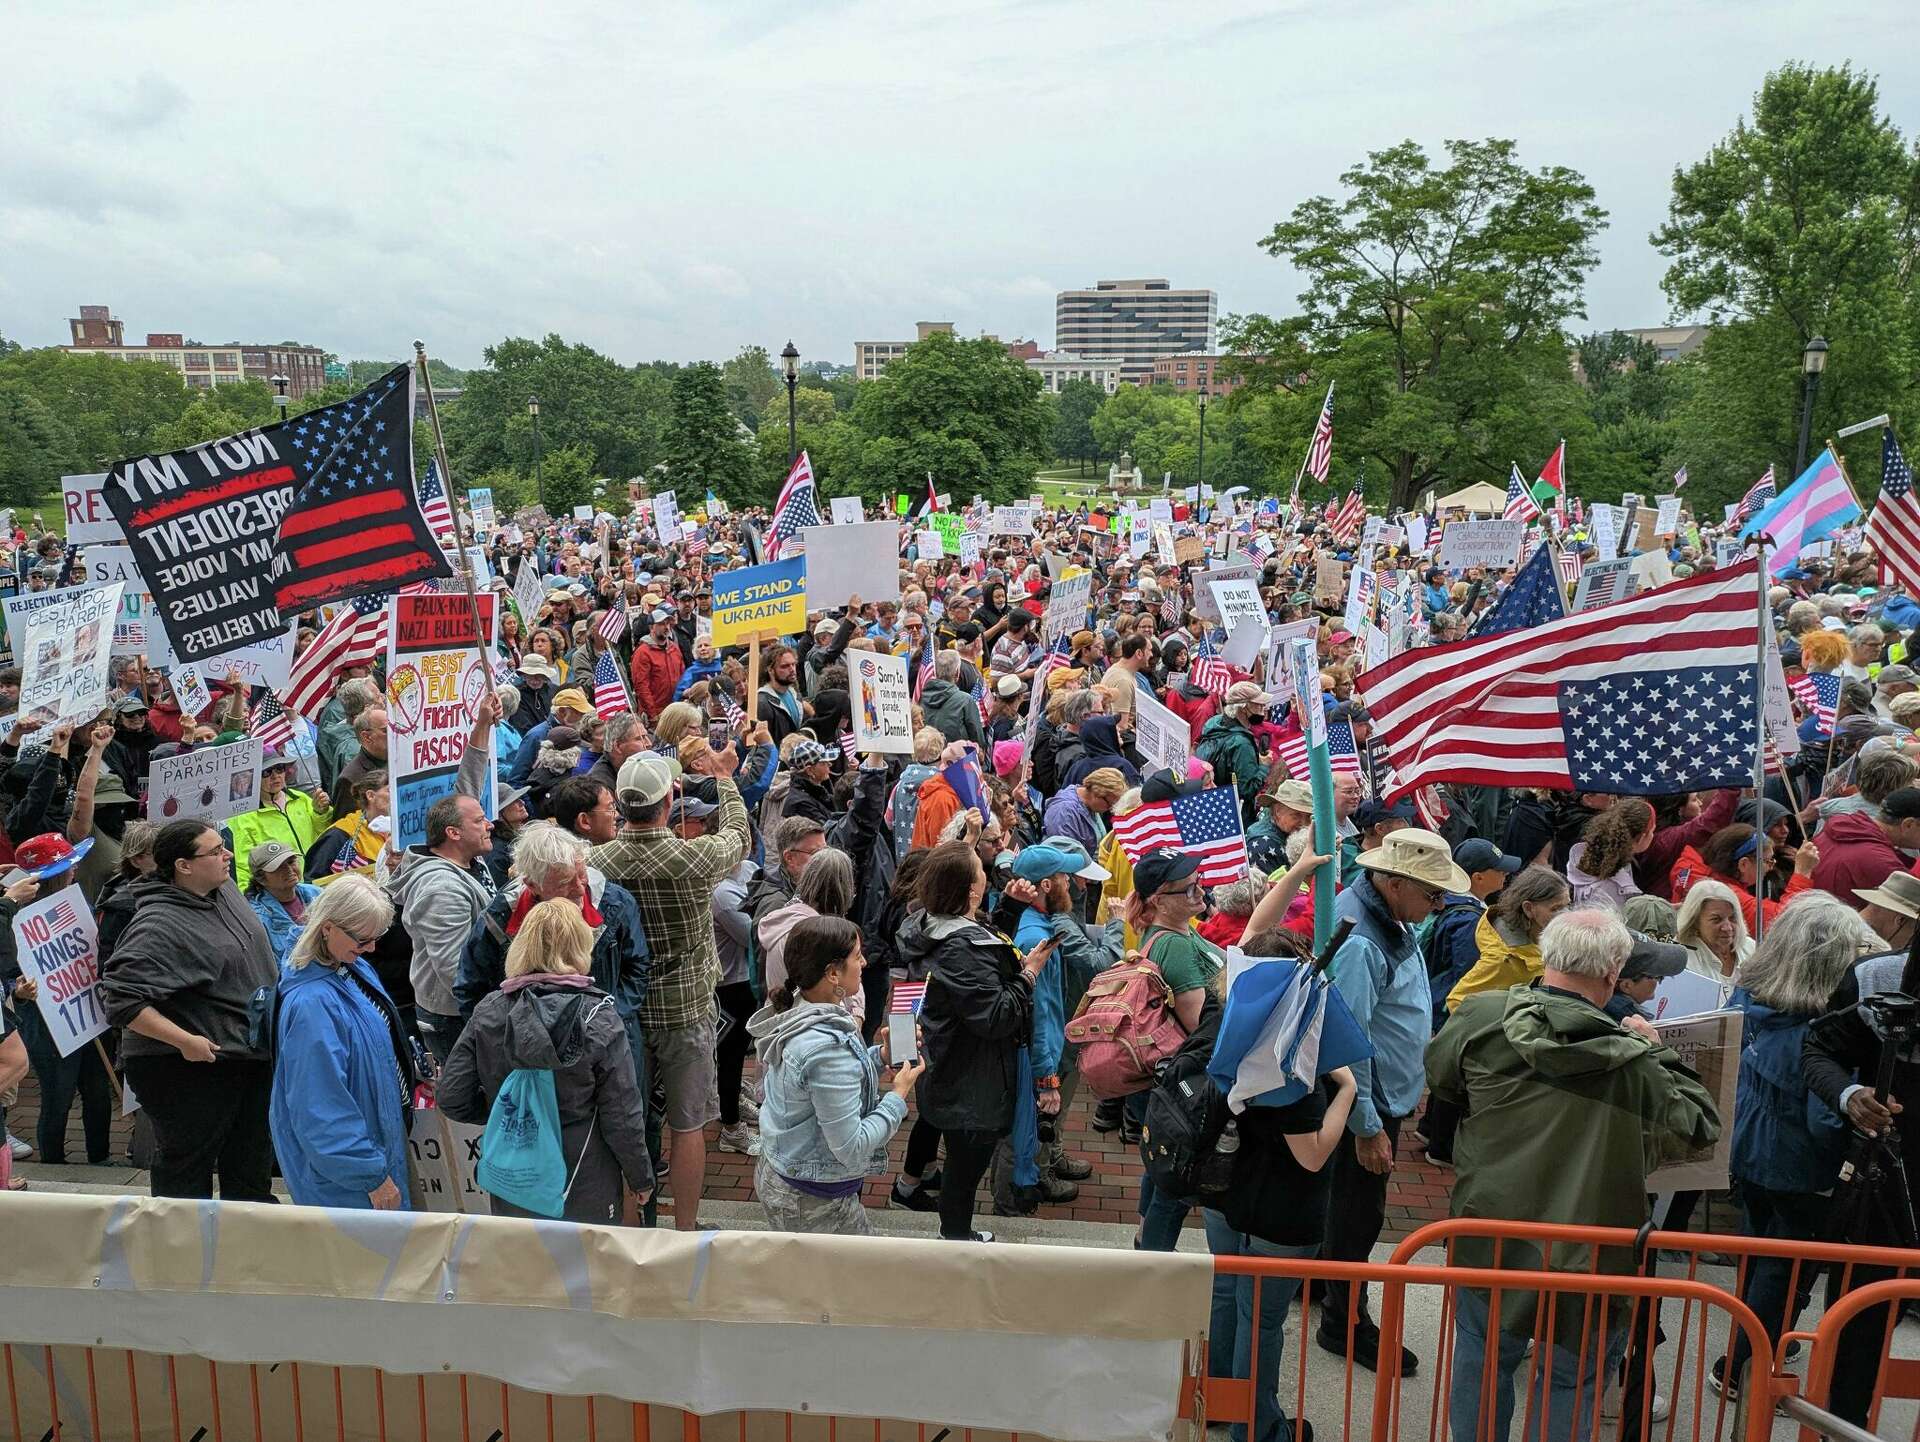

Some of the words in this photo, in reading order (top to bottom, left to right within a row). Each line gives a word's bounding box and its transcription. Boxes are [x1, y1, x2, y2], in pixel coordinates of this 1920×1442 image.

[1134, 530, 1149, 542] KINGS
[1135, 519, 1147, 529] NO
[1463, 555, 1481, 566] JOIN
[1584, 564, 1612, 577] REJECTING
[10, 592, 64, 613] REJECTING
[714, 592, 740, 607] WE
[744, 579, 792, 601] STAND
[796, 575, 807, 589] 4
[1223, 591, 1235, 600] DO
[1236, 590, 1252, 599] NOT
[28, 589, 105, 628] GESTAPO
[55, 600, 111, 635] BARBIE
[413, 597, 478, 617] FAUX-KIN
[723, 600, 792, 625] UKRAINE
[1224, 602, 1260, 613] MINIMIZE
[400, 620, 428, 641] NAZI
[177, 667, 196, 686] YES
[207, 656, 263, 677] GREAT
[421, 652, 467, 677] RESIST
[877, 665, 896, 687] Sorry
[896, 668, 904, 684] to
[21, 664, 95, 705] GESTAPO
[71, 676, 102, 701] KEN
[428, 675, 459, 704] EVIL
[880, 688, 891, 698] rain
[891, 690, 898, 698] on
[897, 690, 907, 701] your
[423, 704, 464, 731] FIGHT
[881, 702, 901, 714] parade,
[883, 714, 910, 738] Donnie!
[160, 754, 203, 771] KNOW
[215, 740, 256, 758] YOUR
[163, 752, 250, 784] PARASITES
[20, 914, 50, 949] NO
[32, 927, 90, 975] KINGS
[46, 953, 101, 1003] SINCE
